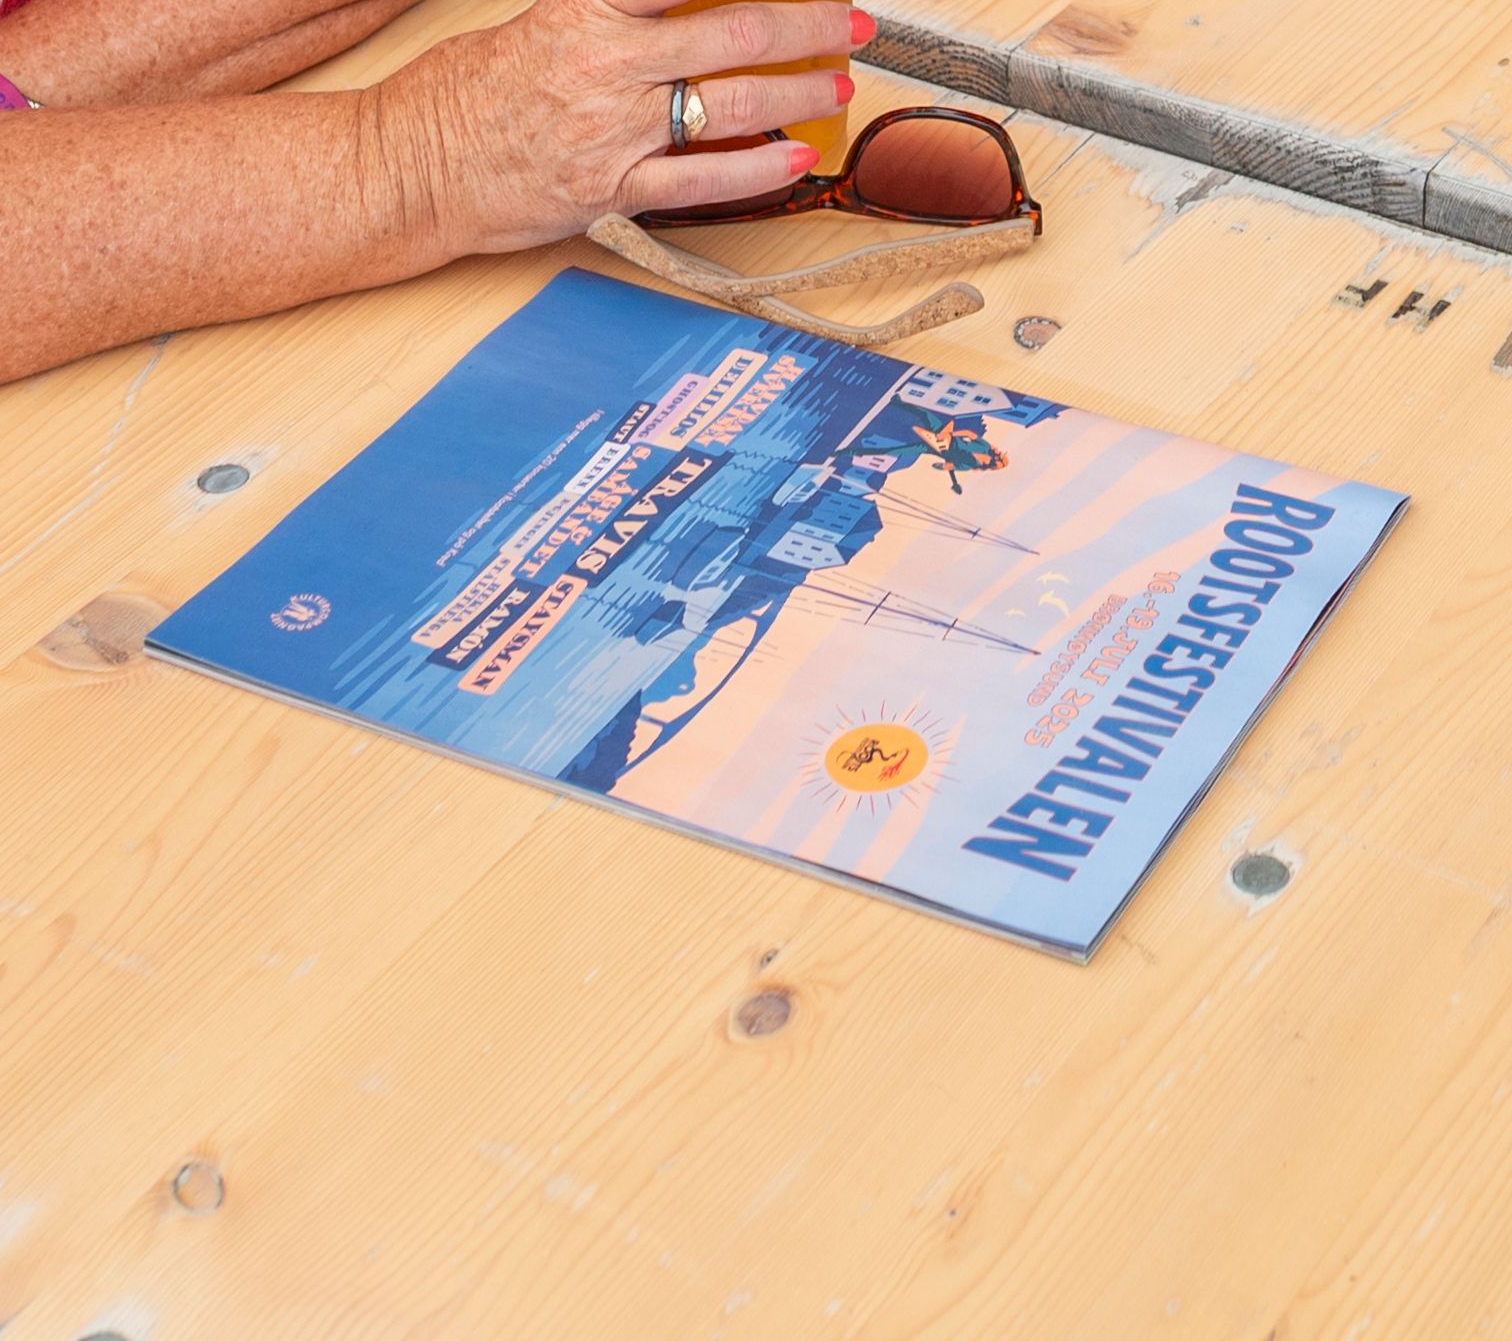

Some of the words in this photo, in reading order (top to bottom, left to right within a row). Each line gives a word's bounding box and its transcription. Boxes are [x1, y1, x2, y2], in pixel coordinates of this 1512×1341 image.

[663, 356, 758, 438] DELILLOS
[509, 445, 658, 578] SAMBANDET
[564, 525, 597, 546] &
[569, 451, 714, 575] TRAVIS
[582, 480, 643, 526] ÅGE
[442, 586, 536, 665] RAMÓN
[461, 580, 584, 690] STAYSMAN
[1024, 592, 1129, 708] BRØNNØYSUND
[960, 482, 1338, 882] ROOTSFESTIVALEN
[1022, 687, 1095, 751] 2025
